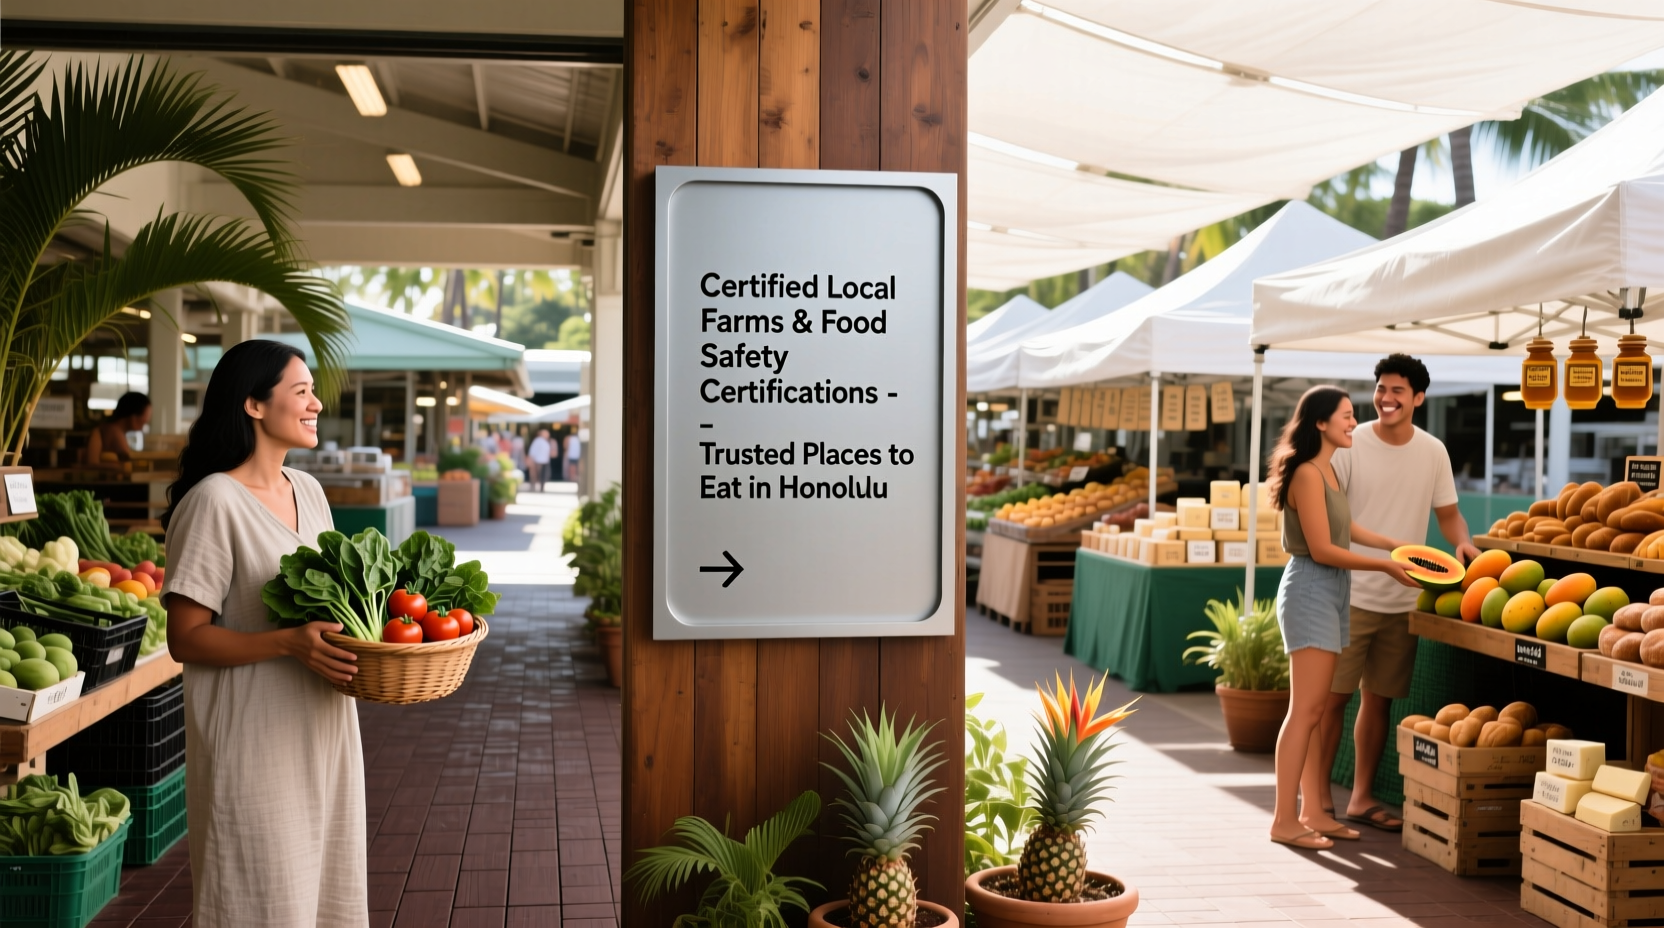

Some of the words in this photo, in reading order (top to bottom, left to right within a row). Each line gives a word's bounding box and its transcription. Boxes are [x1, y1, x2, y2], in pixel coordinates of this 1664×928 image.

[701, 272, 818, 298] Certified
[828, 275, 895, 299] Local
[702, 308, 783, 333] Farms
[792, 309, 812, 333] &
[822, 310, 886, 334] Food
[701, 343, 789, 374] Safety
[700, 378, 878, 404] Certifications
[699, 442, 794, 465] Trusted
[804, 442, 881, 465] Places
[888, 444, 914, 465] to
[701, 475, 742, 499] Eat
[750, 475, 771, 499] in
[780, 475, 887, 499] Honolulu
